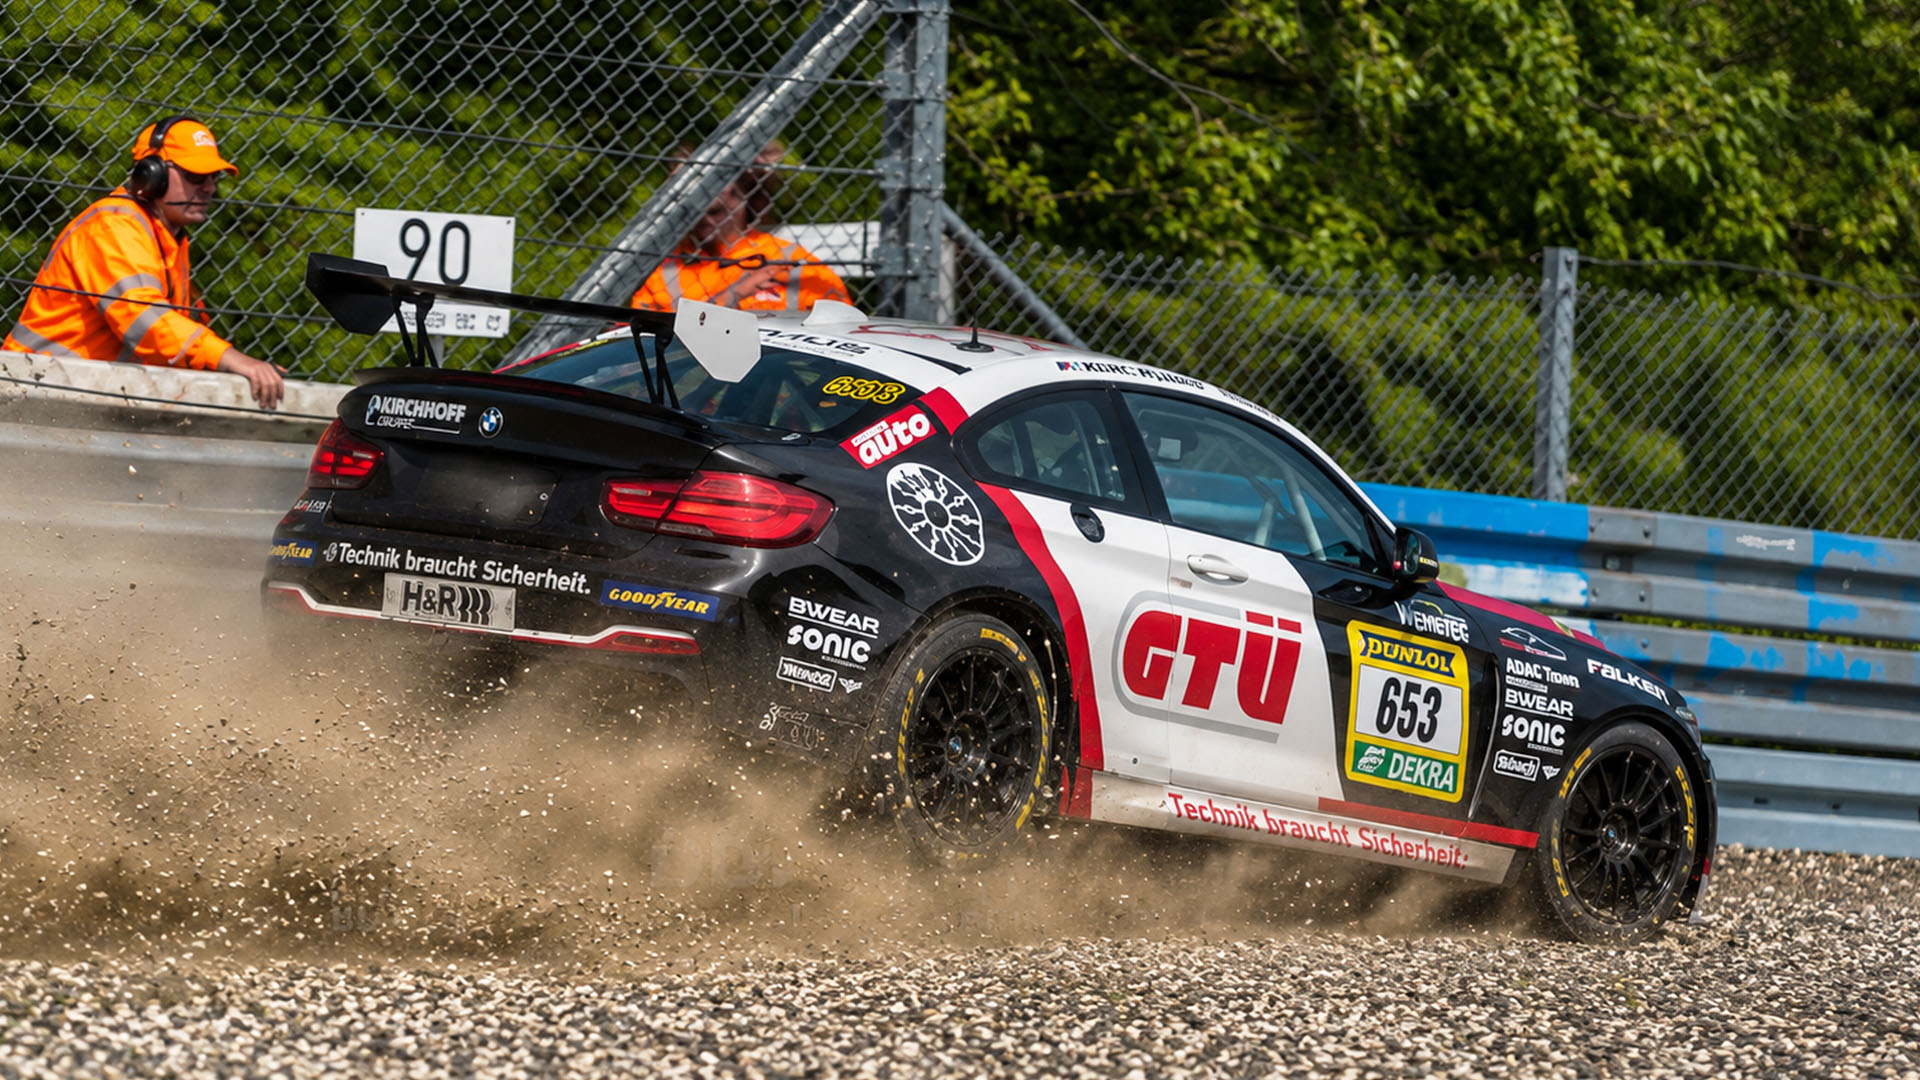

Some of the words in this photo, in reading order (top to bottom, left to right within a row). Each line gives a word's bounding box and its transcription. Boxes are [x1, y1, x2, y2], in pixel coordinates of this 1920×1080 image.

[399, 218, 471, 286] 90
[380, 396, 467, 422] KIRCHHOFF
[858, 413, 930, 464] auto
[339, 542, 400, 569] Technik
[404, 549, 477, 579] braucht
[482, 560, 591, 595] Sicherheit.
[608, 588, 710, 614] GOODYEAR
[789, 596, 880, 635] BWEAR
[787, 624, 871, 663] SONIC
[1123, 609, 1302, 725] GTÜ
[1506, 657, 1543, 679] ADAC
[1376, 677, 1443, 743] 653
[1504, 688, 1575, 717] BWEAR
[1501, 714, 1567, 747] SONIC
[1387, 752, 1455, 792] DEKRA
[1168, 792, 1260, 832] Technik
[1264, 808, 1352, 848] braucht
